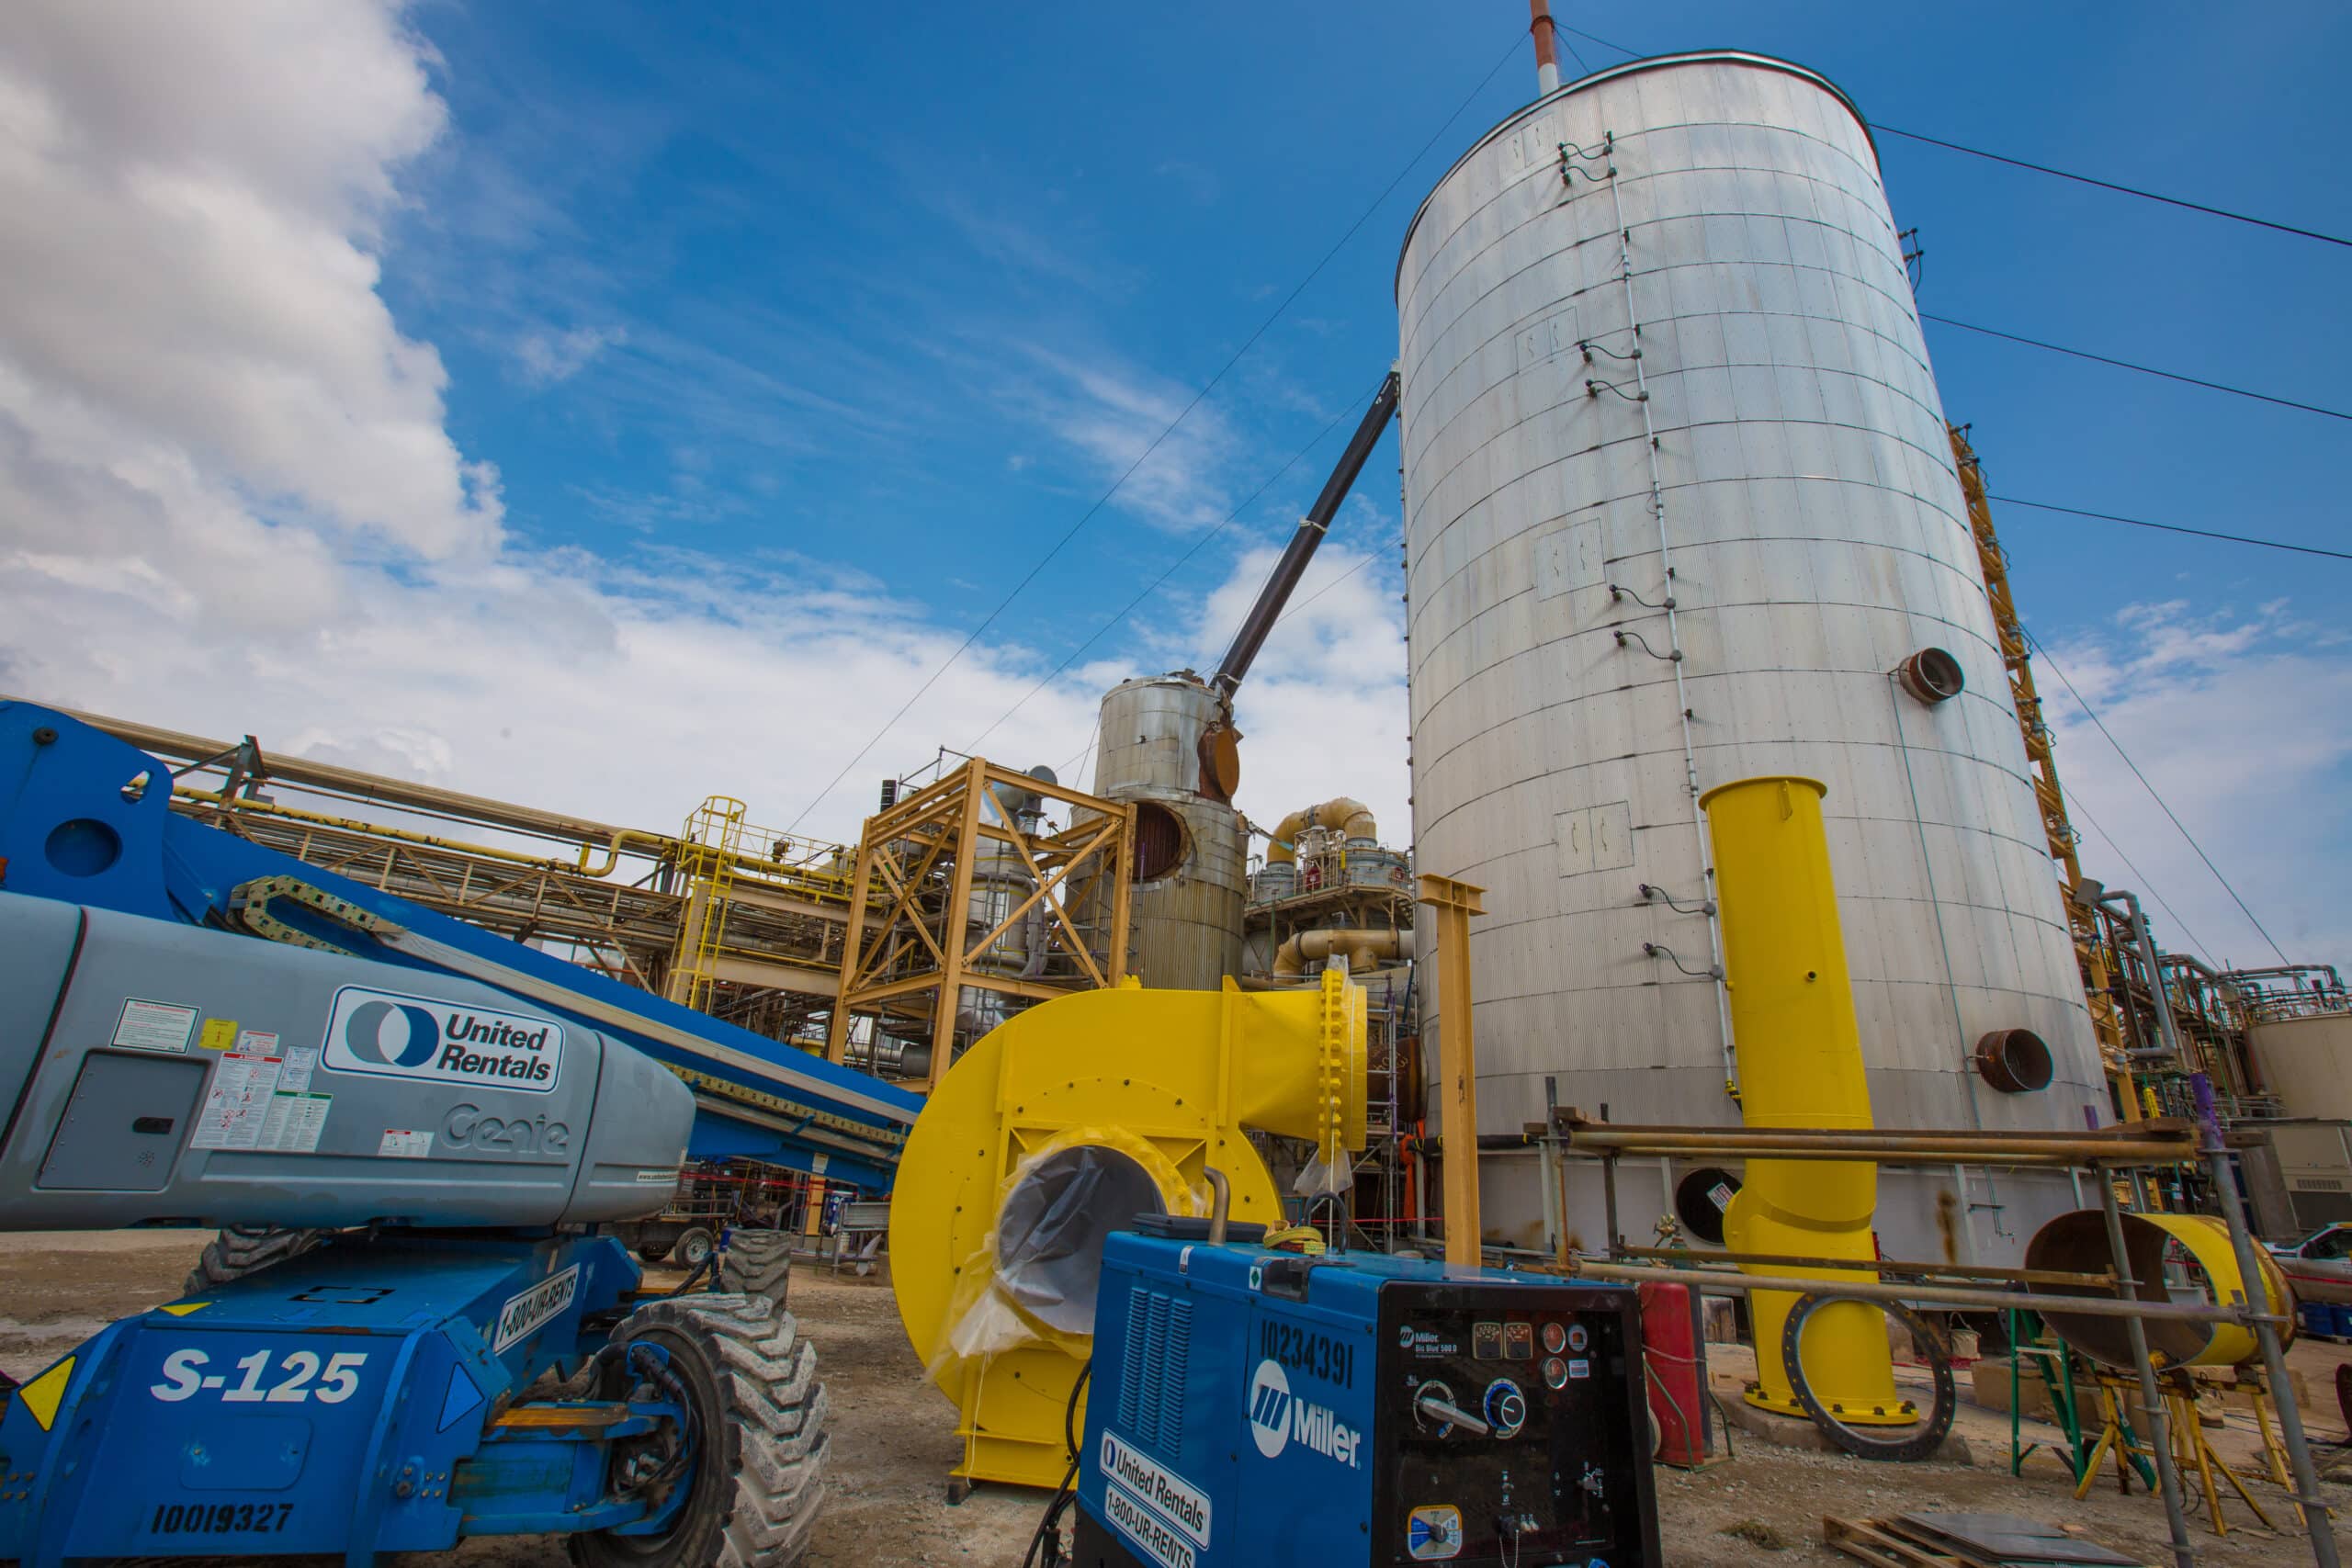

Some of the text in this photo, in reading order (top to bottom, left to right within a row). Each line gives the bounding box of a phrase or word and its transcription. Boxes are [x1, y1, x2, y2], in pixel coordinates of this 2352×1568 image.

[436, 1043, 551, 1081] Rentals
[445, 1013, 548, 1052] United
[440, 1102, 570, 1156] Genie
[498, 1272, 577, 1344] 1-800-UR-RENTS
[150, 1348, 368, 1404] S-125
[1261, 1319, 1354, 1390] 10234391
[1294, 1397, 1361, 1468] Miller
[150, 1503, 294, 1534] 10019327
[1116, 1448, 1204, 1532] United Rentals
[1107, 1491, 1193, 1568] 1-800-UR-RENTS
